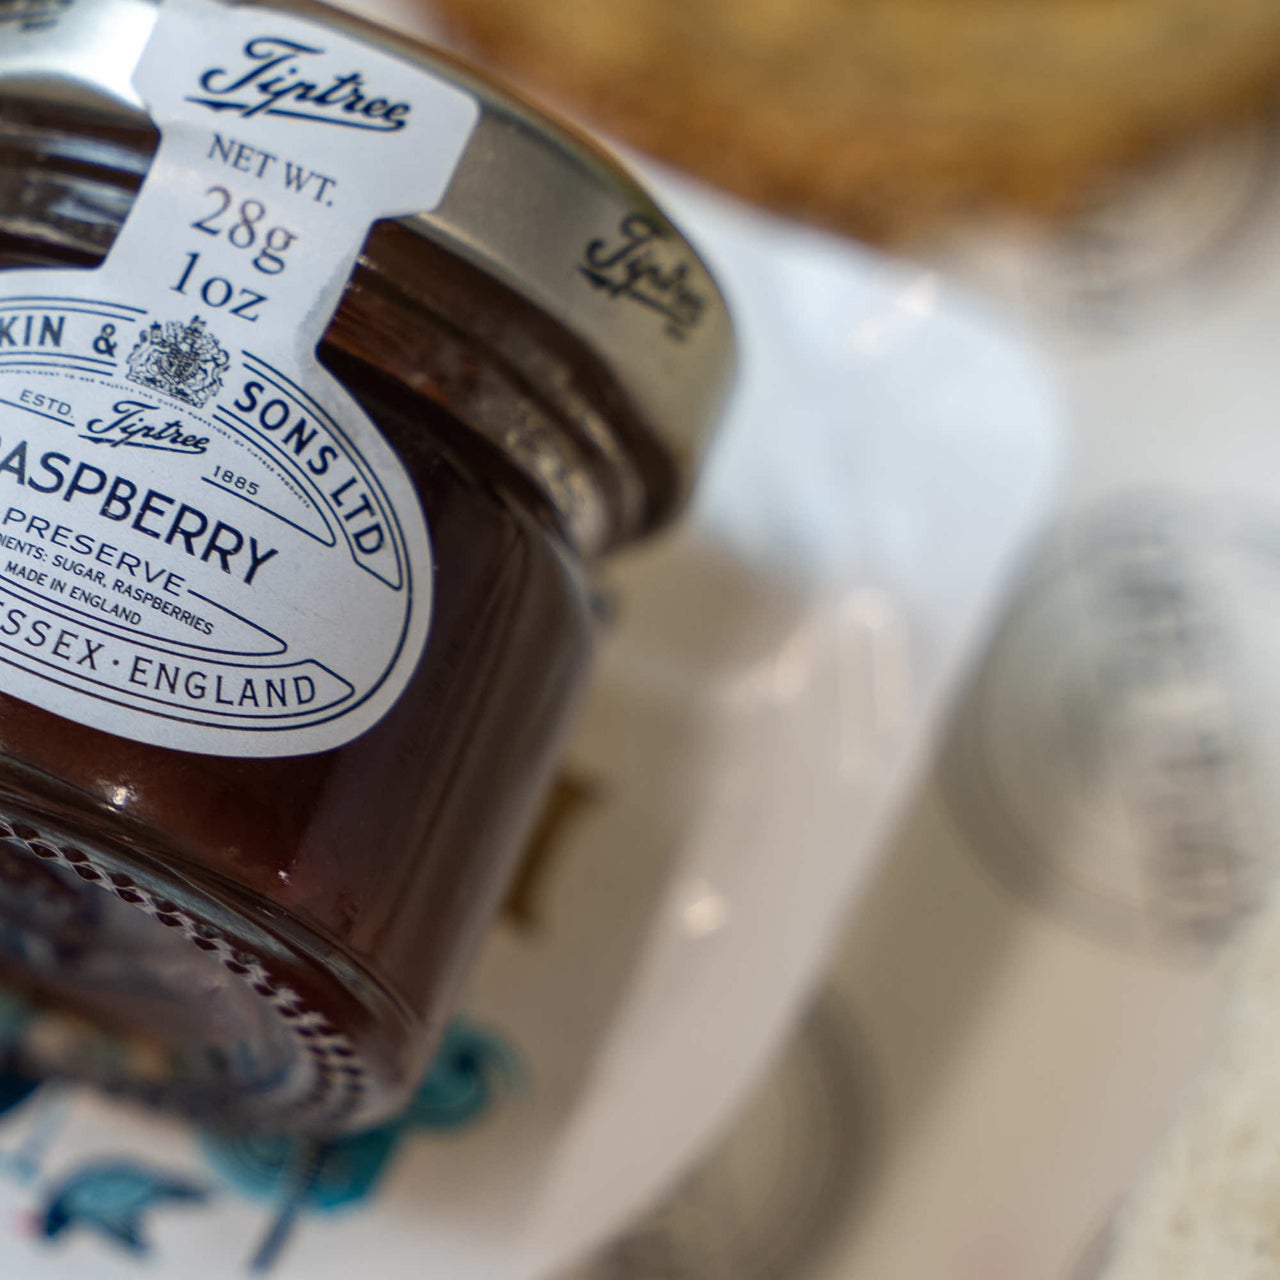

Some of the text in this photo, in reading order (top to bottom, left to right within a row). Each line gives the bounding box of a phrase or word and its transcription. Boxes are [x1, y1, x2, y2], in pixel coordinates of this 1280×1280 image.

[184, 36, 411, 132] Tiptree
[207, 133, 337, 208] NET WT.
[190, 185, 298, 276] 28g
[78, 400, 211, 454] Tiptree
[93, 323, 118, 358] &
[233, 381, 339, 476] SONS
[329, 476, 385, 555] LTD
[212, 465, 260, 496] 1885
[1, 507, 186, 598] PRESERVE
[4, 560, 142, 626] MADE IN ENGLAND
[51, 554, 107, 588] SUGAR,
[112, 578, 215, 636] RASPBERRIES
[128, 655, 316, 708] ENGLAND
